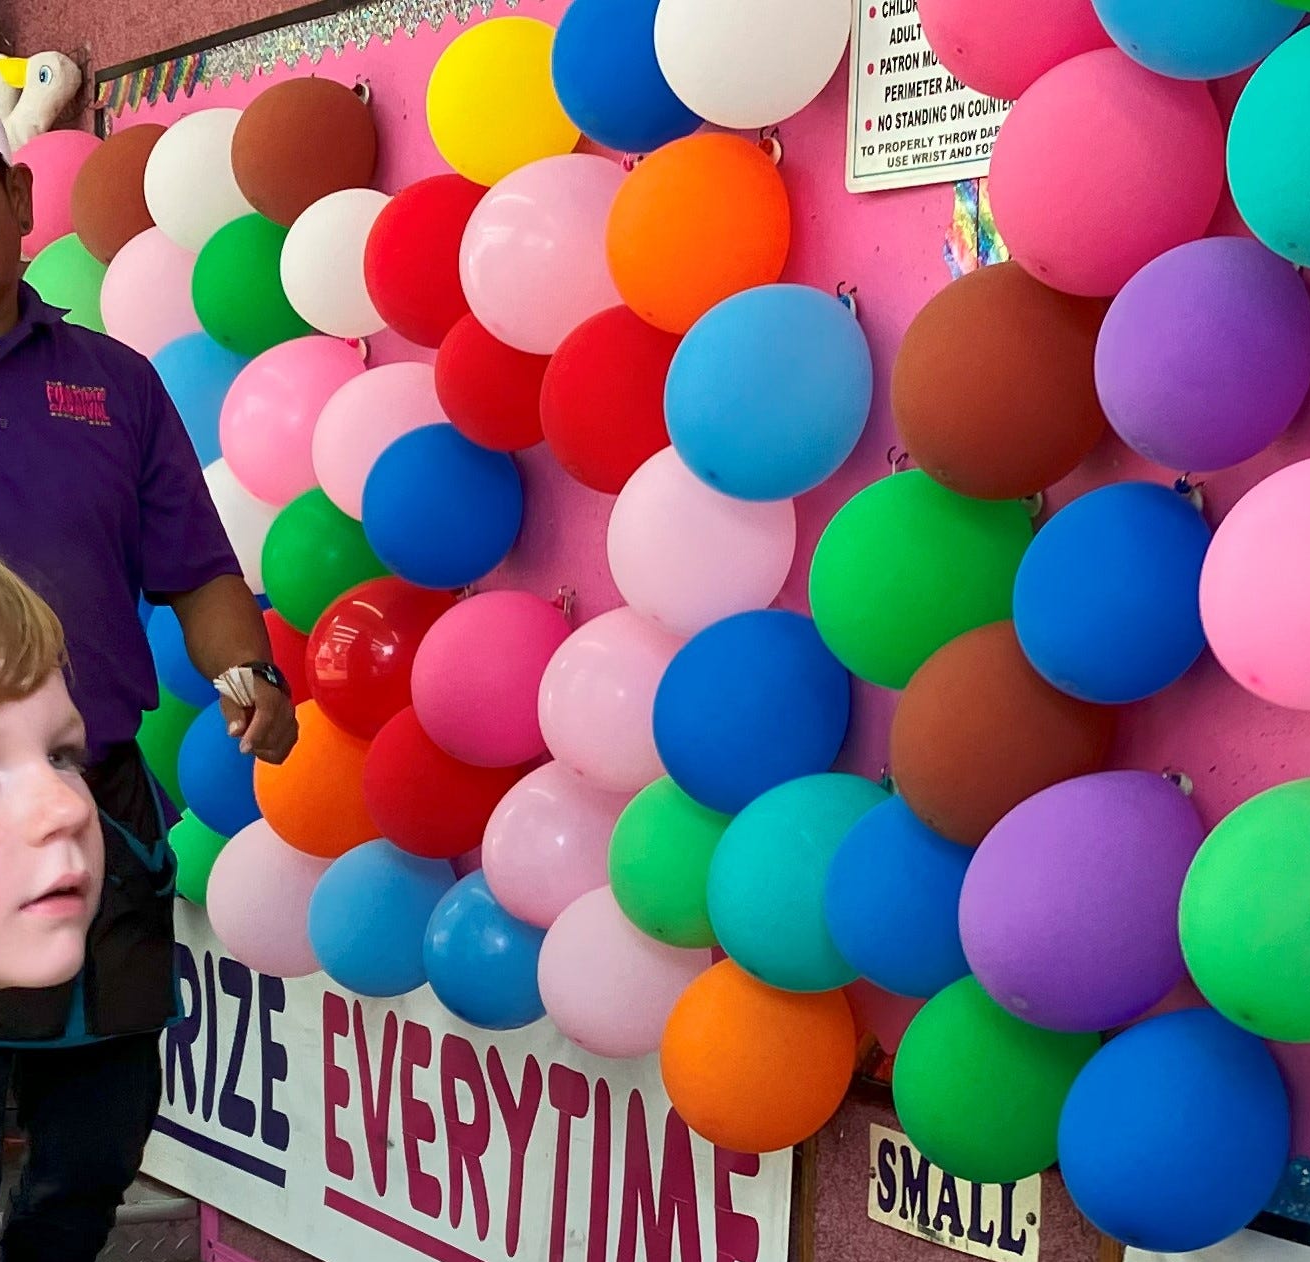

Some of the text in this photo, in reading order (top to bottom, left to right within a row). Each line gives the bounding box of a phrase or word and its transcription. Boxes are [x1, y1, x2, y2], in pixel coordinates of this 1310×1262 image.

[889, 23, 922, 46] ADULT
[880, 50, 942, 75] PATRON MU
[885, 77, 942, 104] PERIMETER
[877, 114, 892, 132] NO
[895, 105, 947, 129] STANDING
[950, 102, 966, 120] ON
[861, 145, 875, 157] TO
[878, 136, 935, 155] PROPERLY
[938, 129, 977, 146] THROW
[887, 154, 909, 168] USE
[912, 150, 947, 165] WRIST
[949, 146, 972, 159] AND
[877, 1138, 1027, 1256] SMALL
